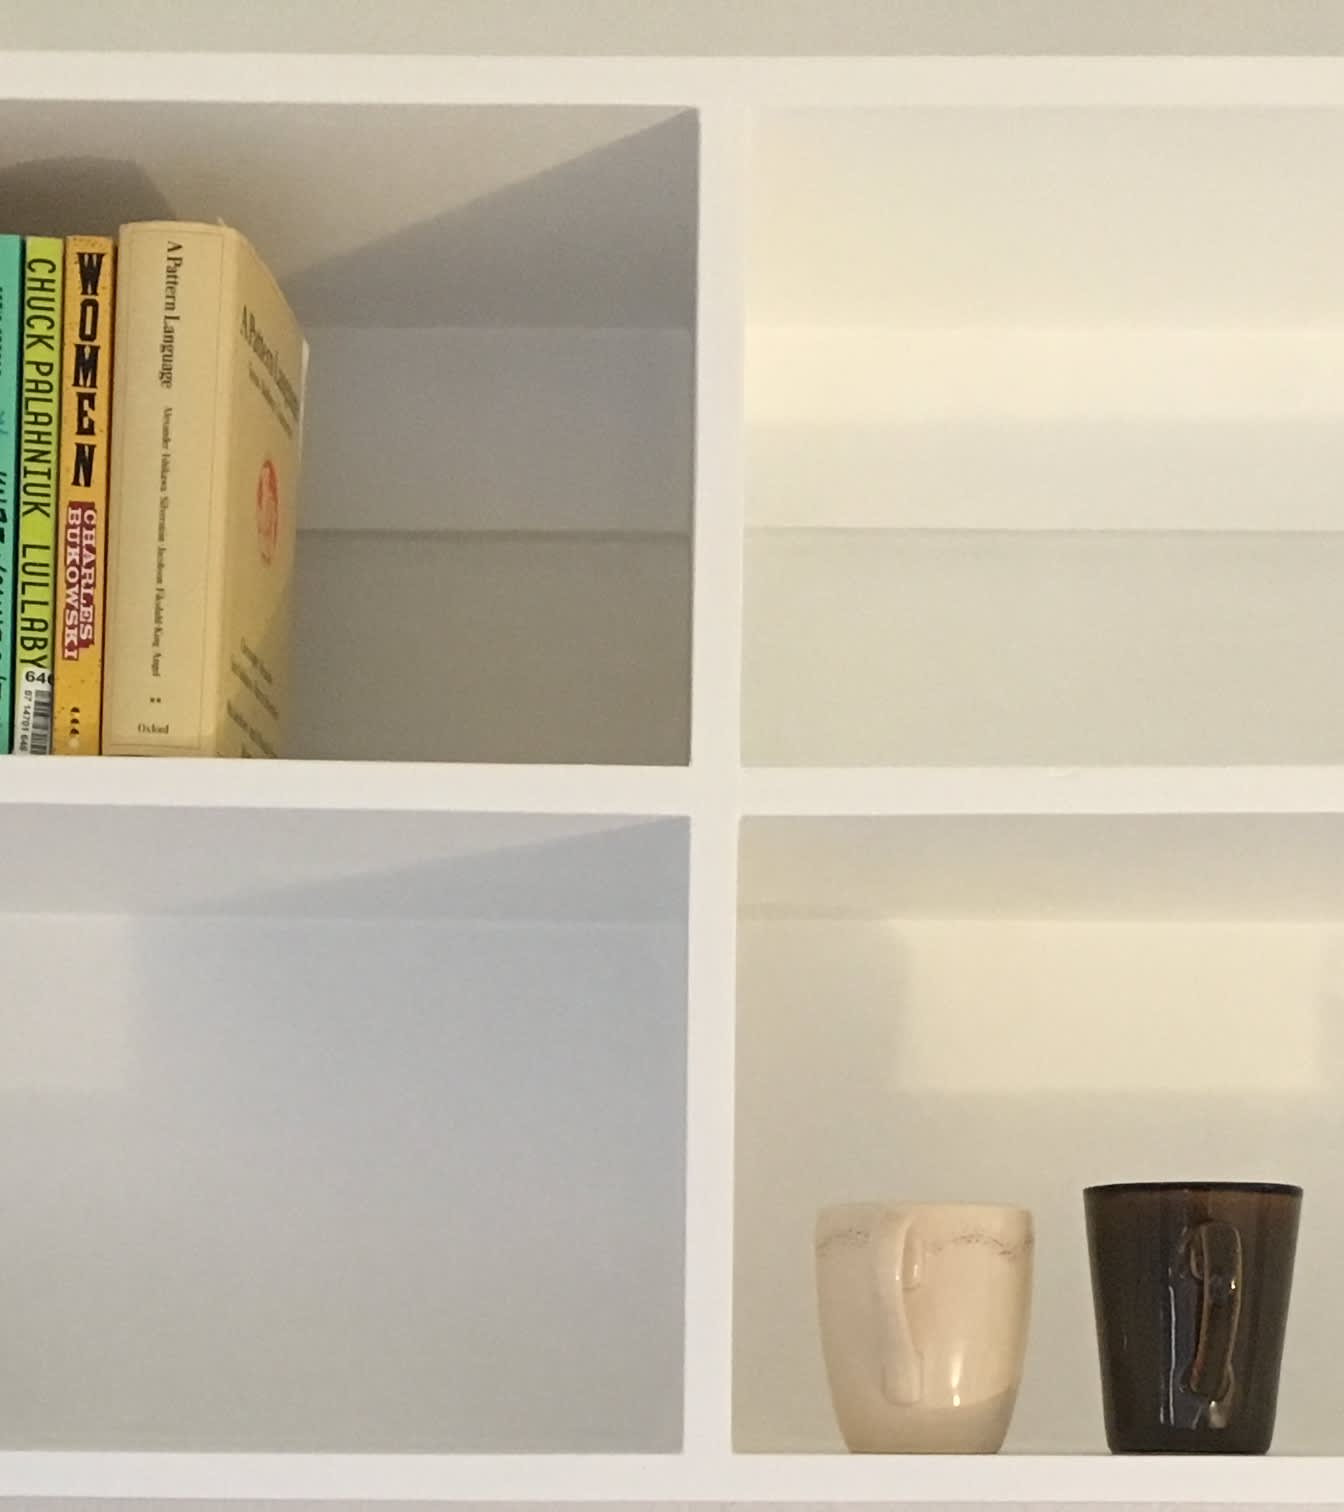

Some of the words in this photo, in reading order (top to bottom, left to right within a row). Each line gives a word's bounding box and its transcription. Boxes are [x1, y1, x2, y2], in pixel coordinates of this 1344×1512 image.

[164, 256, 183, 312] Pattern
[166, 240, 183, 253] A
[25, 258, 57, 352] CHUCK
[159, 315, 181, 389] Language
[71, 252, 106, 488] WOMEN
[22, 361, 54, 518] PALAHNIUK
[19, 543, 51, 670] LULLABY
[64, 507, 82, 660] BUKOWSKI
[79, 510, 97, 641] CHARLES
[137, 723, 169, 735] Oxford
